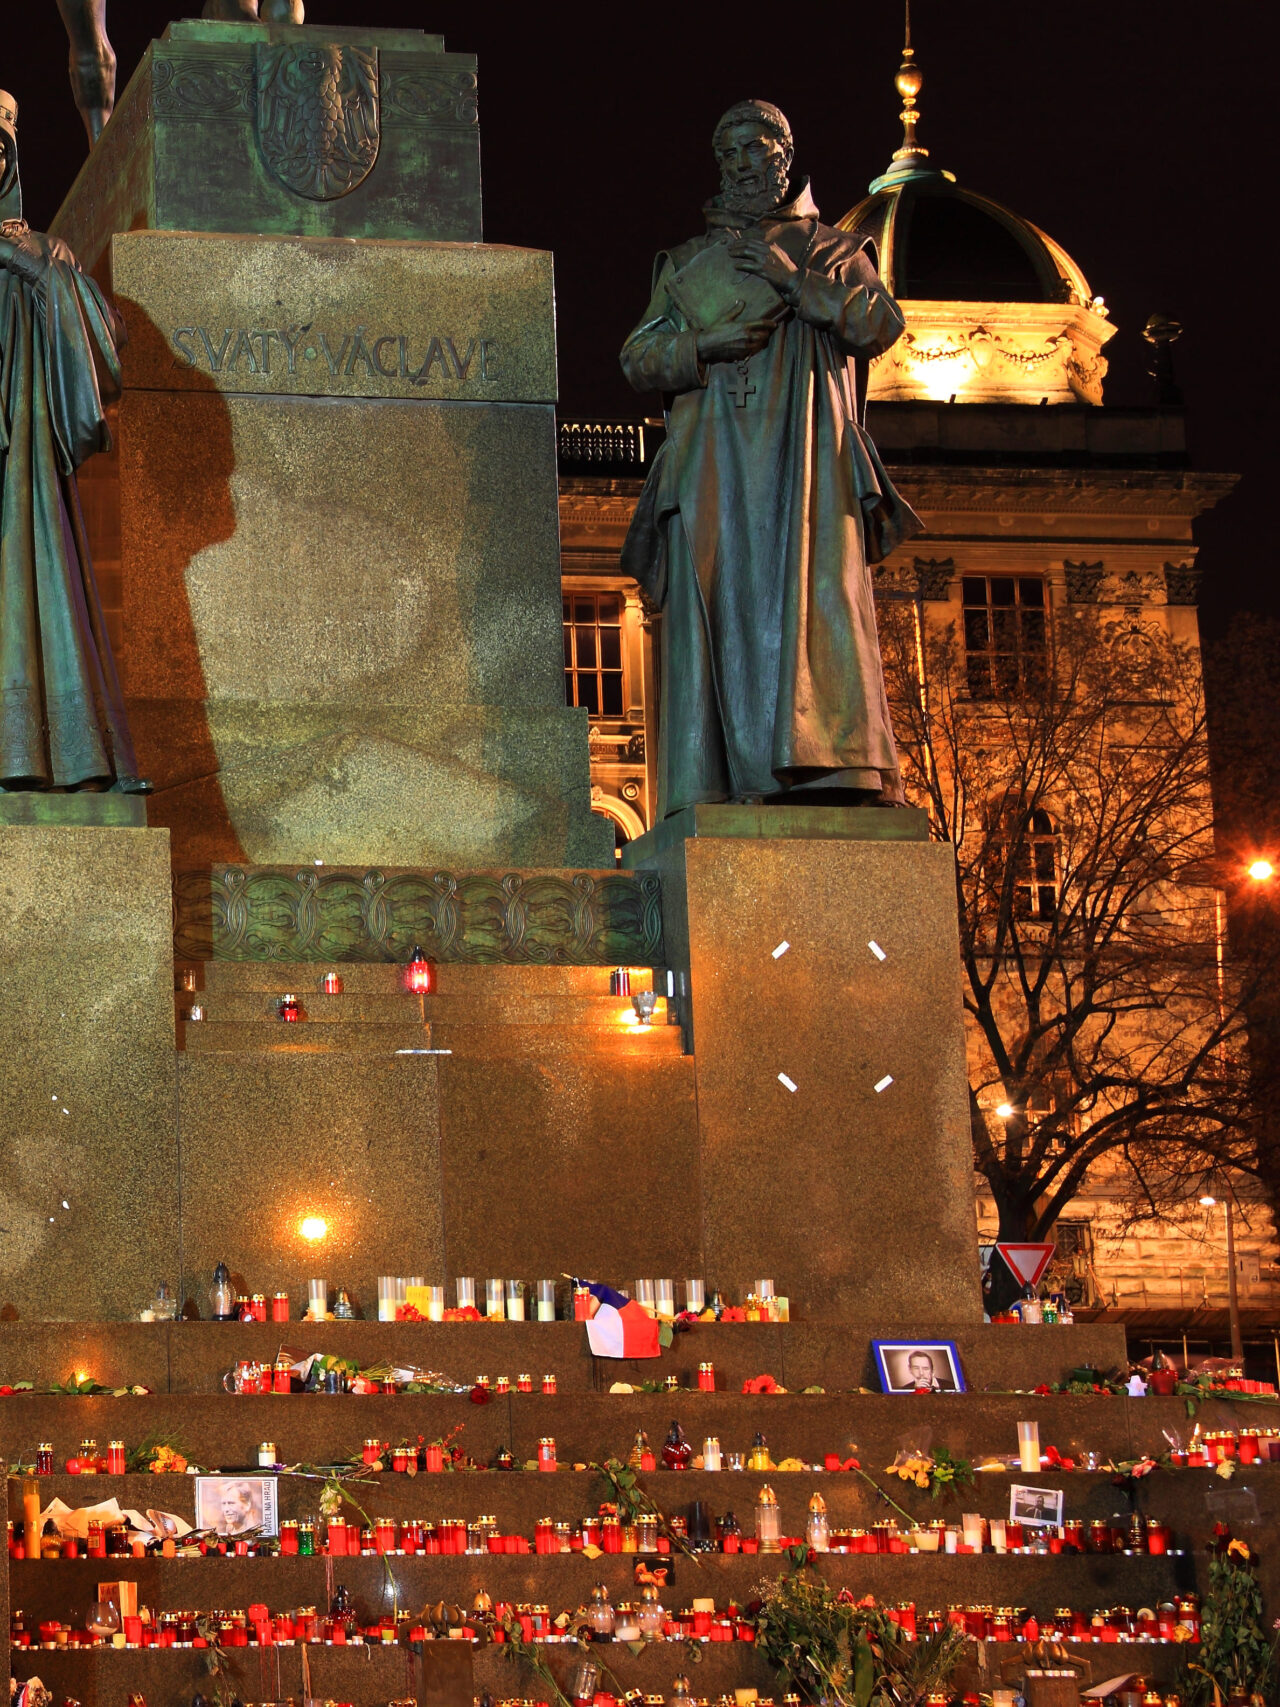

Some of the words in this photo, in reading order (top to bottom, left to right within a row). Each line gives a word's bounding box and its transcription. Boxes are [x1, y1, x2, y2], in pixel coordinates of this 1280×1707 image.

[316, 325, 501, 383] VÁCLAVE
[264, 1501, 272, 1511] NA
[264, 1512, 272, 1534] HAVEL
